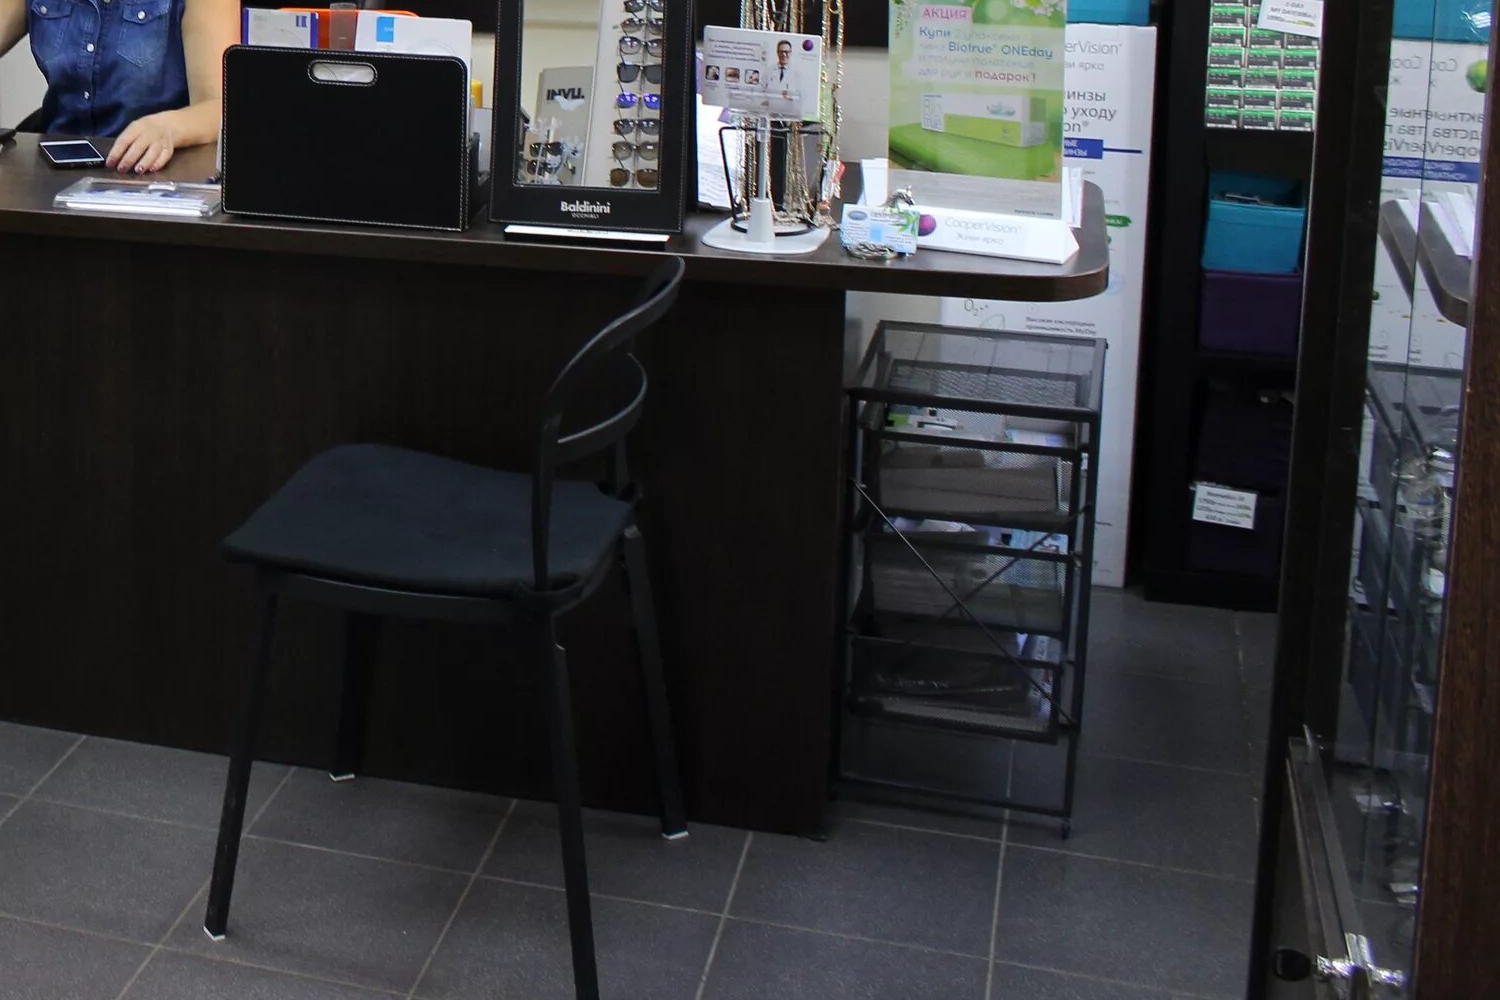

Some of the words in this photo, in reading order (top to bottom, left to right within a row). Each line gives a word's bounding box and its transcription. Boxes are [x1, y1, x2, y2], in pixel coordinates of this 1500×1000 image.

[922, 7, 967, 20] АКЦИЯ
[919, 26, 951, 40] Купи
[948, 41, 994, 54] Biotrue
[1001, 44, 1053, 60] ONEday
[1080, 62, 1104, 71] ярко
[1072, 106, 1117, 120] уходу
[561, 200, 611, 213] Baldinini
[945, 217, 1017, 233] CooperVision
